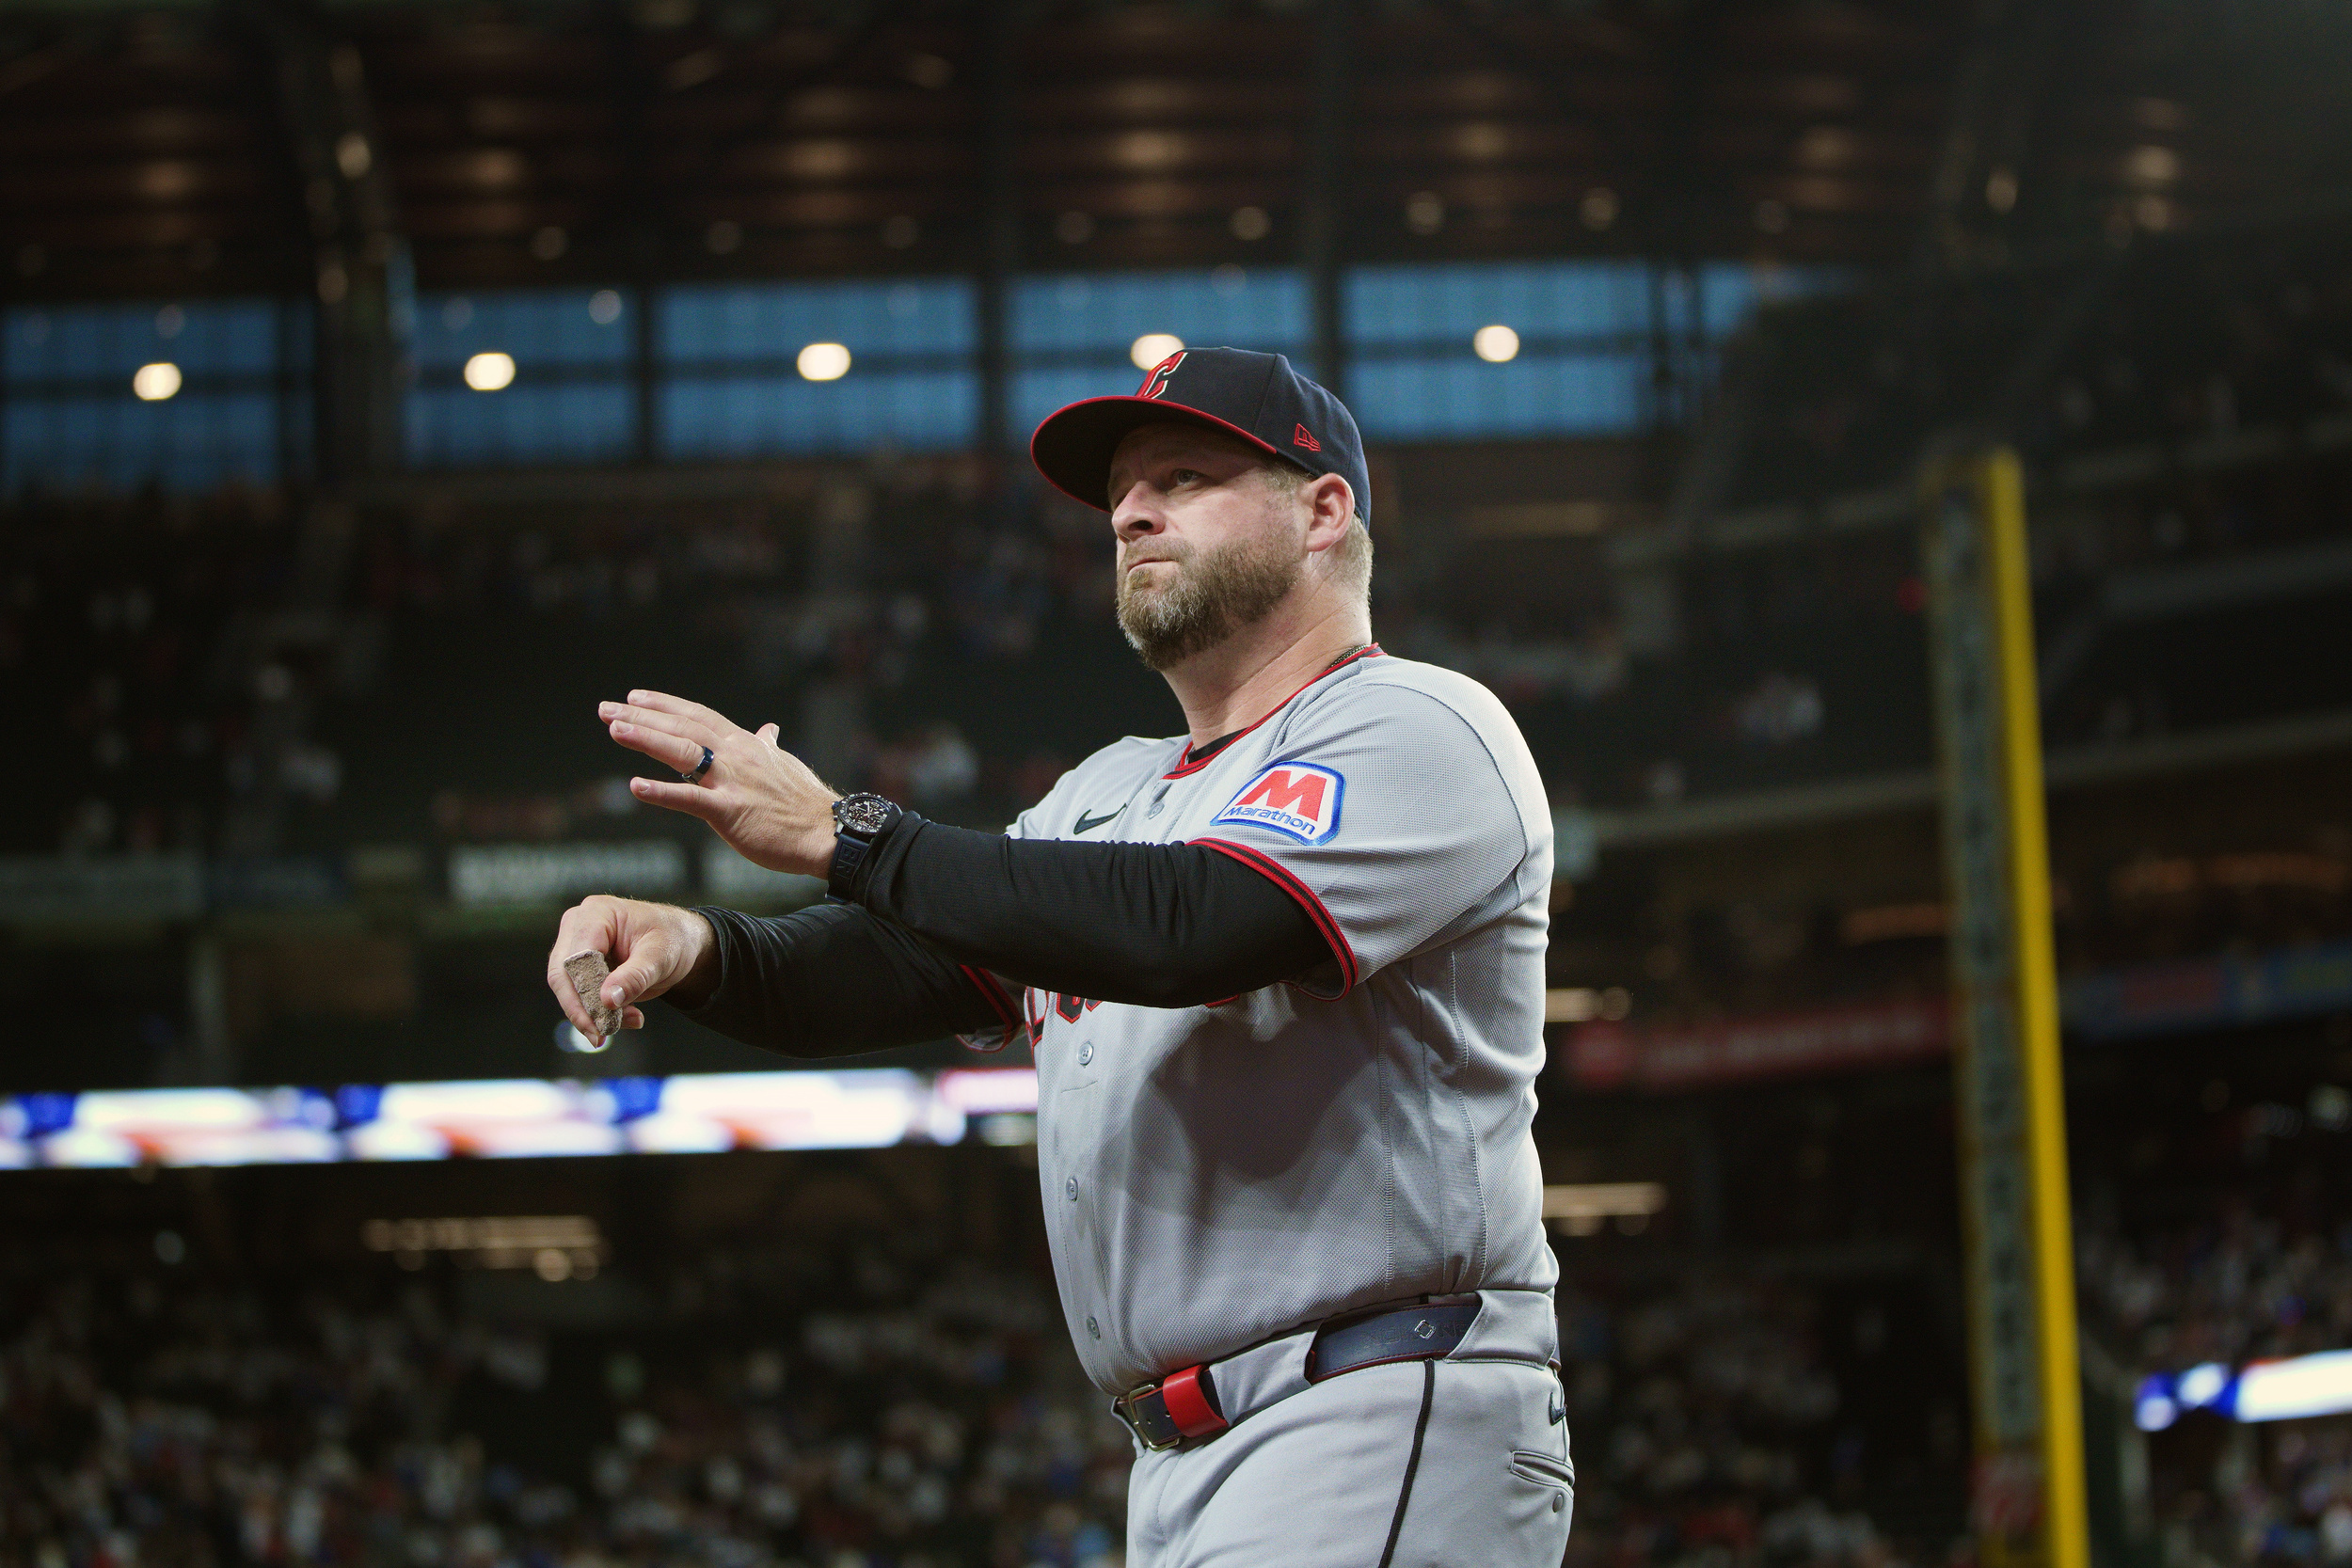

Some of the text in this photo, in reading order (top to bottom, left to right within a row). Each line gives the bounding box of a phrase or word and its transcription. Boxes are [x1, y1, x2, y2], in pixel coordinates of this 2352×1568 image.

[1135, 351, 1189, 400] C
[1234, 769, 1327, 822] M
[1224, 806, 1316, 835] Marathon
